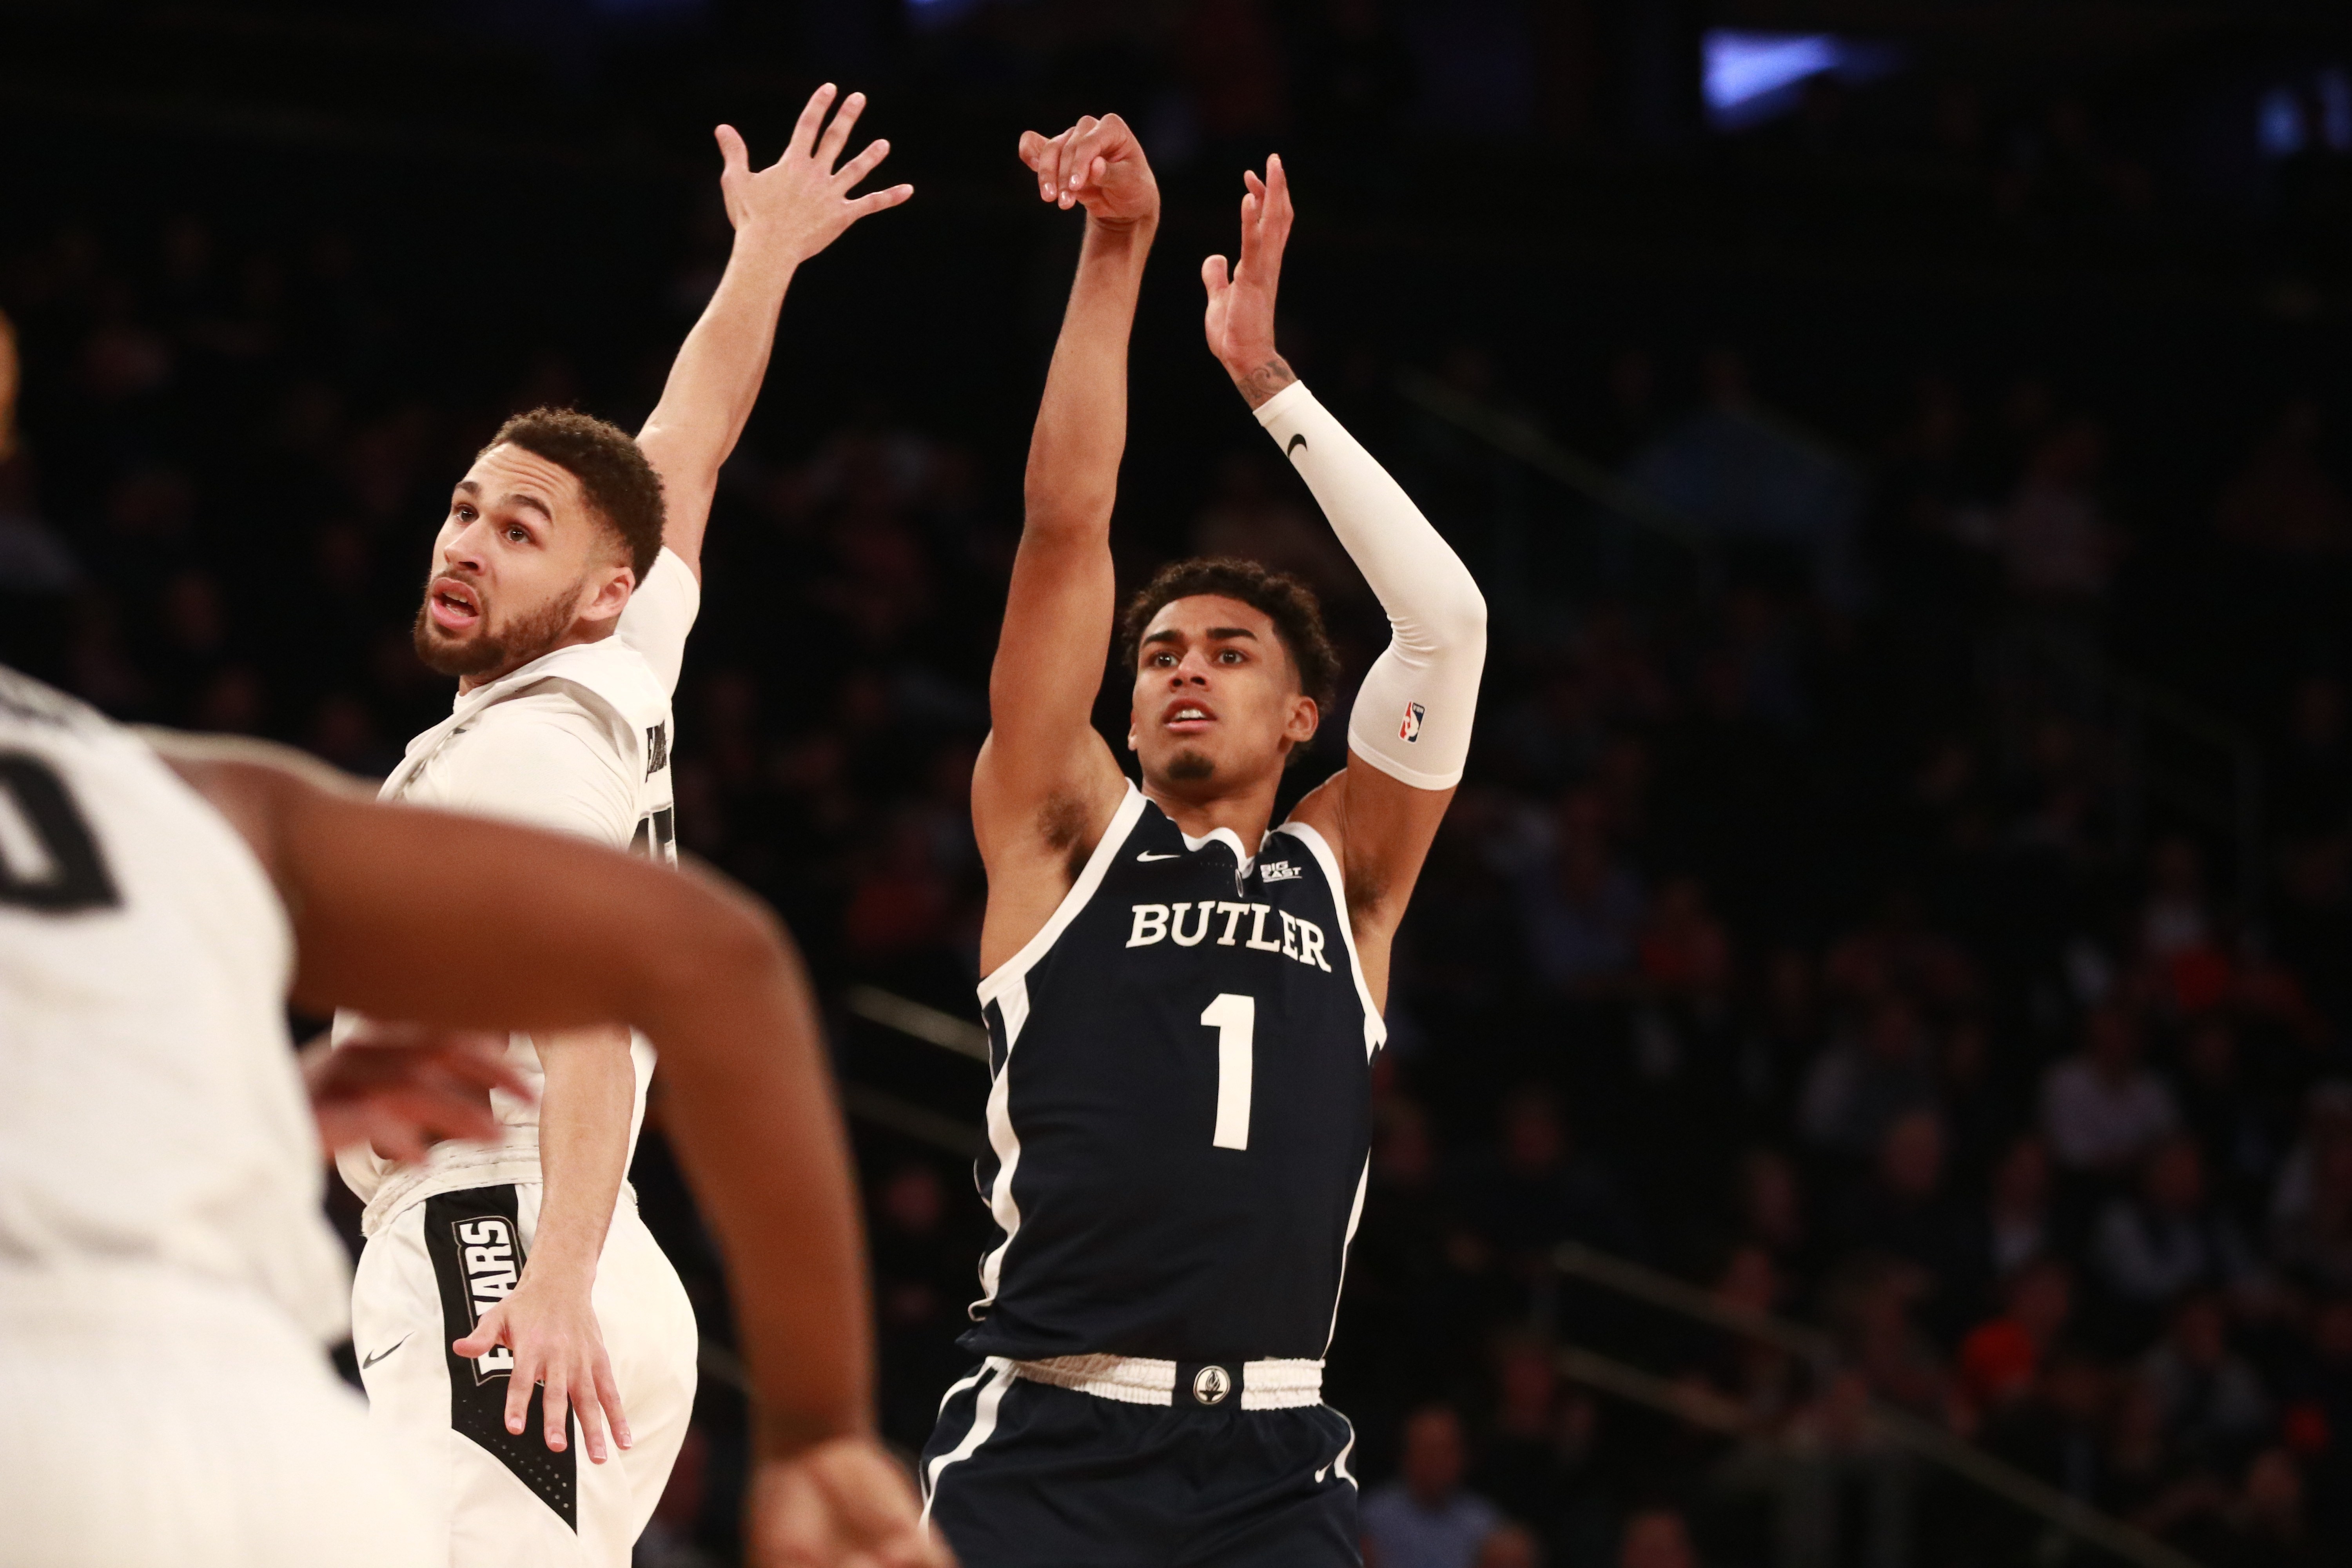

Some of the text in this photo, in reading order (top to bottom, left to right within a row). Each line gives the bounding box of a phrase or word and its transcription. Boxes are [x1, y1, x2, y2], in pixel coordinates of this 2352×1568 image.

[1126, 901, 1332, 972] BUTLER
[1201, 993, 1255, 1150] 1
[459, 1220, 518, 1375] FARS
